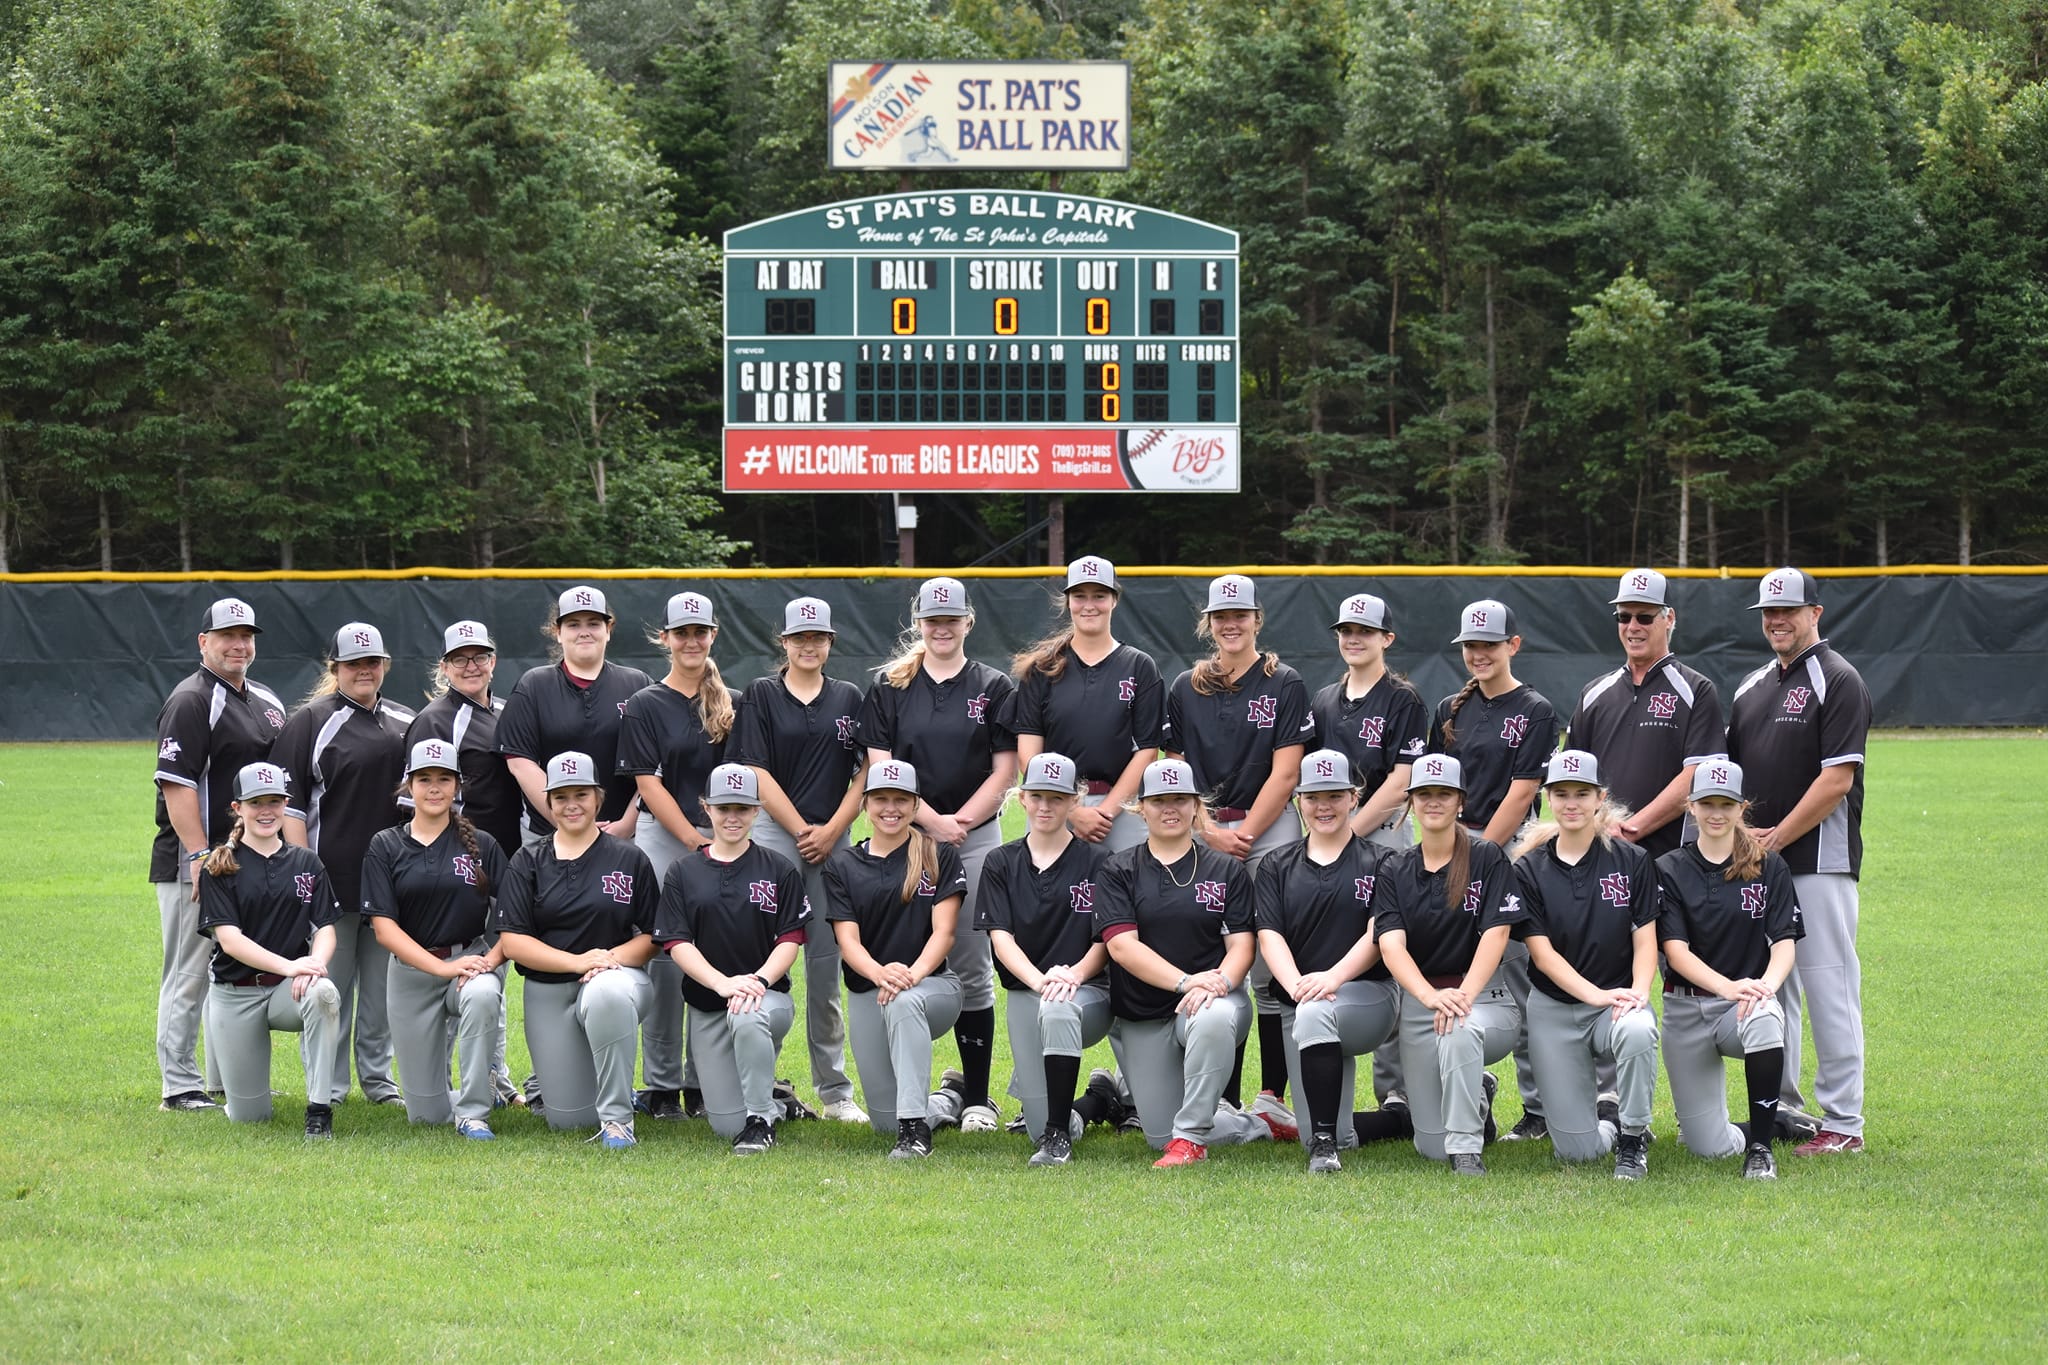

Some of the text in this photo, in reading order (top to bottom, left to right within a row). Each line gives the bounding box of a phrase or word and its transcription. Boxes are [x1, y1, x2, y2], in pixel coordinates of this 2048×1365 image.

[854, 82, 896, 126] MOLSON
[958, 79, 1081, 111] ST. PAT'S
[844, 69, 933, 159] CANADIAN
[958, 119, 1121, 151] BALL PARK
[826, 195, 1137, 230] ST PAT'S BALL PARK
[857, 227, 1110, 246] Home of The St John's Capitals
[757, 260, 824, 290] AT BAT
[880, 260, 928, 290] BALL
[969, 260, 1044, 291] STRIKE
[1077, 260, 1118, 291] OUT
[1155, 261, 1170, 291] H
[1206, 261, 1217, 291] E
[893, 297, 916, 335] 0
[994, 297, 1018, 335] 0
[1086, 297, 1110, 335] 0
[862, 344, 1065, 361] 1 2 3 4 5 6 7 8 9 10
[1084, 344, 1120, 361] RUNS
[1136, 344, 1166, 361] HITS
[1181, 344, 1231, 361] ERRORS
[740, 361, 842, 391] GUESTS
[1102, 363, 1120, 391] 0
[755, 393, 827, 422] HOME
[1102, 393, 1120, 421] 0
[775, 445, 868, 474] WELCOME
[870, 454, 888, 474] TO
[890, 454, 915, 474] THE
[920, 445, 951, 474] BIG
[957, 445, 1040, 474] LEAGUES
[1247, 695, 1277, 729] NL
[1648, 692, 1679, 719] NL
[1783, 687, 1812, 714] NL
[1639, 720, 1679, 729] BASEBALL
[1775, 716, 1808, 725] BASEBALL
[602, 871, 633, 904] NL
[749, 880, 778, 914] NL
[1195, 881, 1227, 913] NL
[1600, 873, 1631, 906] NL
